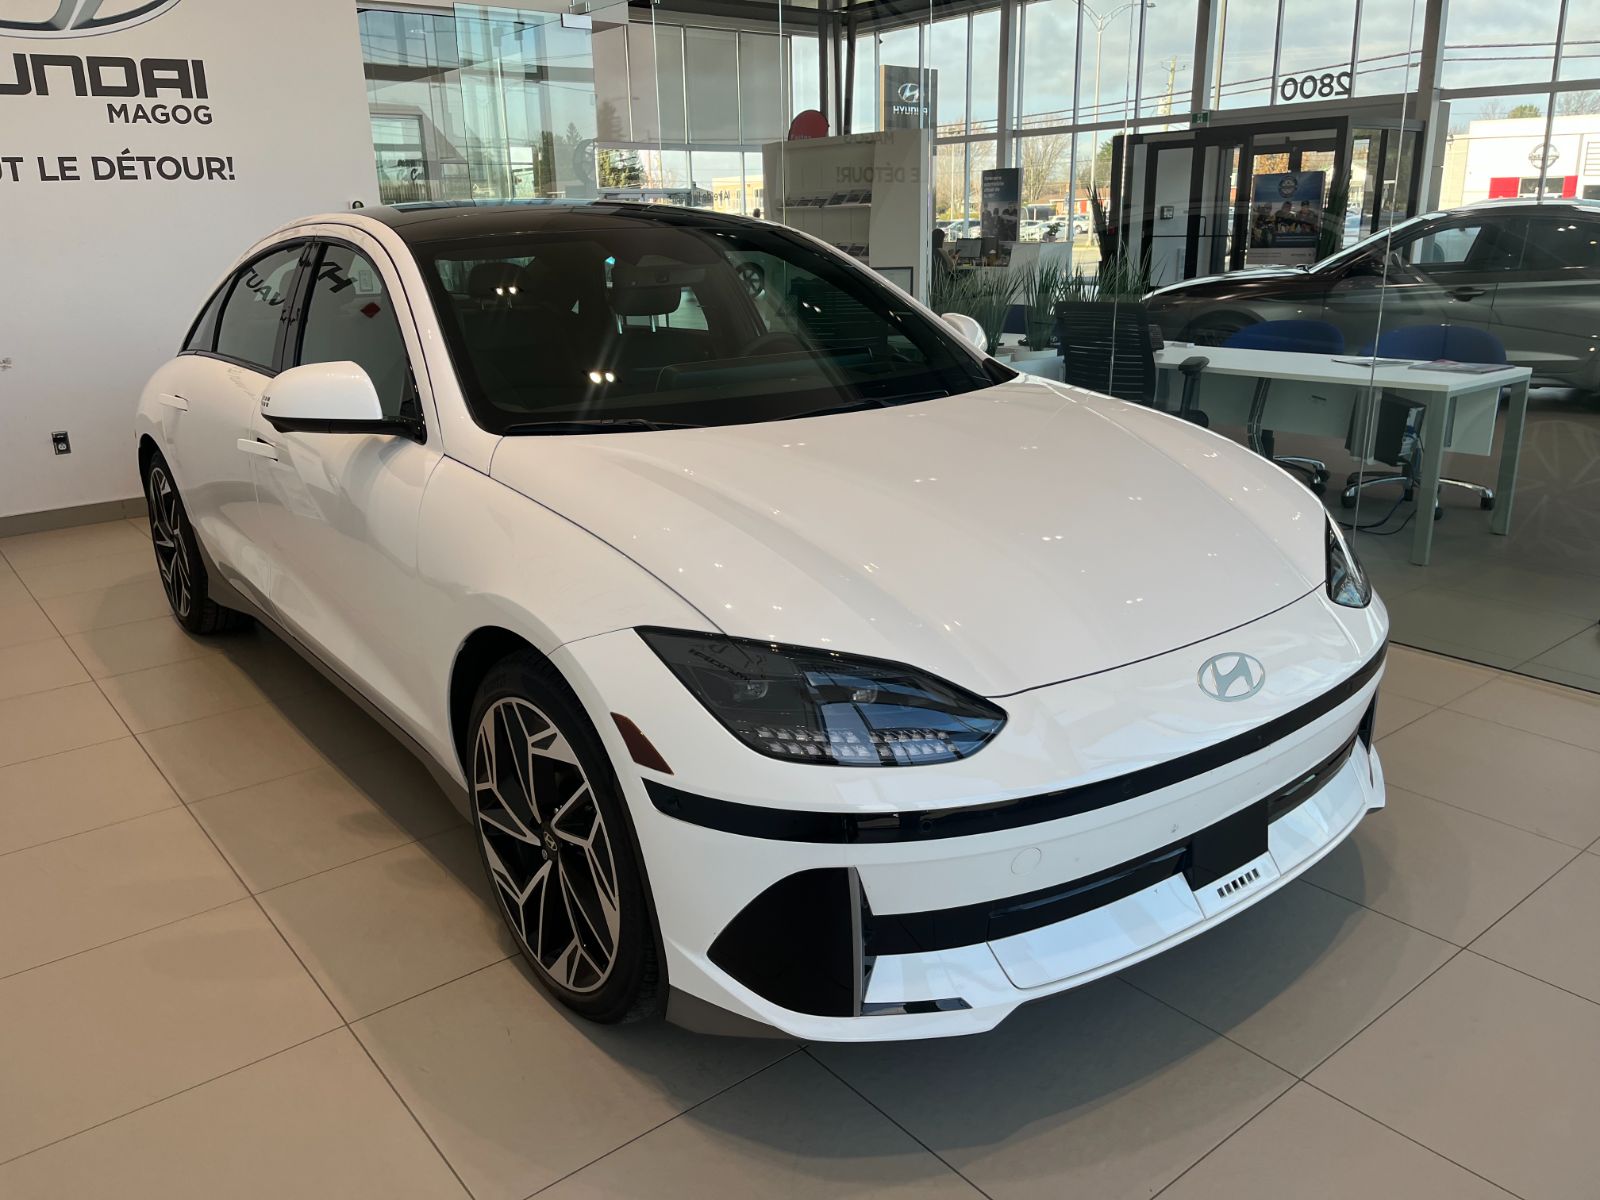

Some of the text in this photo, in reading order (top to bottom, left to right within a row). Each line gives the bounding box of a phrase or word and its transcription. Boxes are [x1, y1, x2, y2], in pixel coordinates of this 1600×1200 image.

[106, 103, 213, 125] MAGOG
[37, 156, 81, 181] LE
[91, 148, 235, 181] DÉTOUR!
